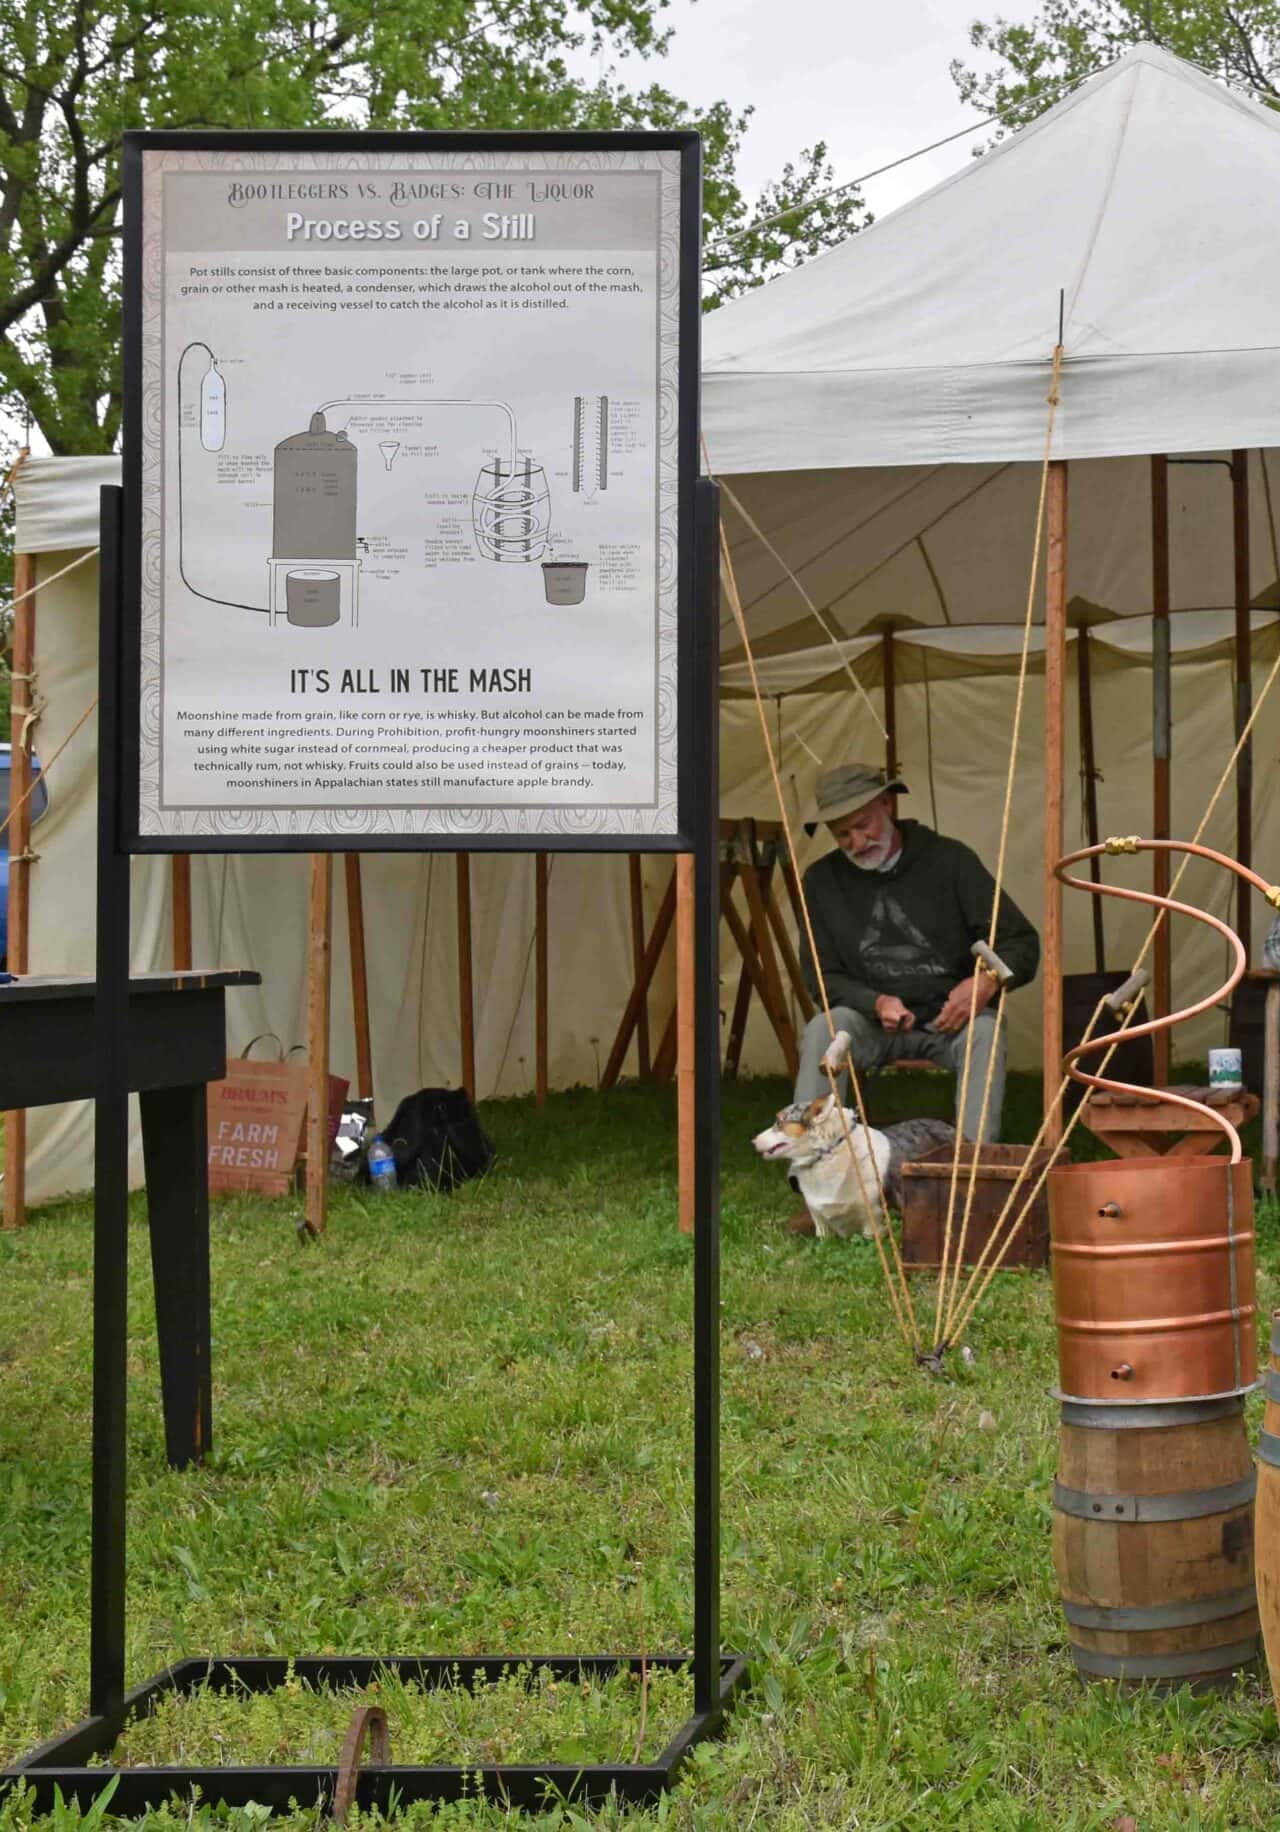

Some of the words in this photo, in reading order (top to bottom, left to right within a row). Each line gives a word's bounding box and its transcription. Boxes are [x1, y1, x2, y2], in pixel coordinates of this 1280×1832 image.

[286, 212, 403, 241] Process
[413, 214, 443, 240] of
[453, 219, 471, 241] a
[482, 212, 537, 241] Still
[190, 267, 207, 277] Pot
[211, 267, 235, 276] stills
[238, 267, 276, 276] consist
[279, 267, 289, 276] of
[293, 267, 322, 276] three
[325, 266, 352, 276] basic
[430, 266, 449, 276] the
[452, 266, 479, 278] large
[521, 266, 546, 275] tank
[548, 266, 583, 275] where
[585, 266, 604, 275] the
[181, 284, 209, 296] grain
[226, 283, 256, 293] other
[259, 283, 289, 293] mash
[291, 284, 300, 293] is
[346, 285, 352, 293] a
[418, 283, 451, 292] which
[454, 283, 486, 292] draws
[489, 283, 508, 292] the
[510, 283, 550, 292] alcohol
[553, 283, 572, 292] out
[575, 282, 587, 292] of
[589, 282, 608, 292] the
[253, 300, 274, 309] and
[287, 300, 337, 312] receiving
[340, 300, 373, 309] vessel
[375, 300, 387, 309] to
[390, 299, 419, 309] catch
[422, 299, 440, 309] the
[443, 299, 483, 309] alcohol
[500, 300, 508, 309] it
[511, 300, 519, 309] is
[291, 669, 330, 694] IT'S
[340, 668, 380, 694] ALL
[390, 669, 410, 693] IN
[420, 668, 460, 693] THE
[469, 668, 532, 693] MASH
[177, 711, 239, 720] Moonshine
[242, 710, 273, 720] made
[276, 710, 302, 720] from
[340, 710, 359, 720] like
[362, 712, 386, 720] corn
[389, 712, 401, 720] or
[427, 710, 436, 719] is
[481, 710, 499, 719] But
[502, 709, 542, 719] alcohol
[568, 709, 581, 719] be
[584, 709, 615, 719] made
[618, 709, 643, 719] from
[184, 729, 214, 739] many
[217, 727, 264, 737] different
[336, 727, 374, 739] During
[445, 726, 520, 739] profit-hungry
[523, 726, 595, 736] moonshiners
[598, 726, 636, 735] started
[198, 745, 228, 756] using
[231, 744, 261, 754] white
[264, 746, 295, 756] sugar
[298, 744, 338, 754] instead
[341, 744, 352, 753] of
[413, 744, 470, 756] producing
[481, 743, 527, 756] cheaper
[530, 743, 573, 755] product
[576, 743, 598, 753] that
[601, 745, 622, 753] was
[194, 761, 253, 773] technically
[284, 762, 302, 770] not
[349, 760, 379, 770] Fruits
[382, 760, 412, 770] could
[416, 760, 438, 770] also
[442, 760, 455, 770] be
[458, 760, 484, 770] used
[487, 760, 528, 770] instead
[531, 760, 542, 770] of
[545, 760, 578, 772] grains
[227, 777, 298, 787] moonshiners
[301, 778, 311, 787] in
[315, 777, 383, 789] Appalachian
[386, 778, 418, 787] states
[421, 777, 440, 786] still
[443, 777, 514, 786] manufacture
[517, 777, 548, 789] apple
[217, 1120, 279, 1145] FARM
[208, 1145, 279, 1169] FRESH
